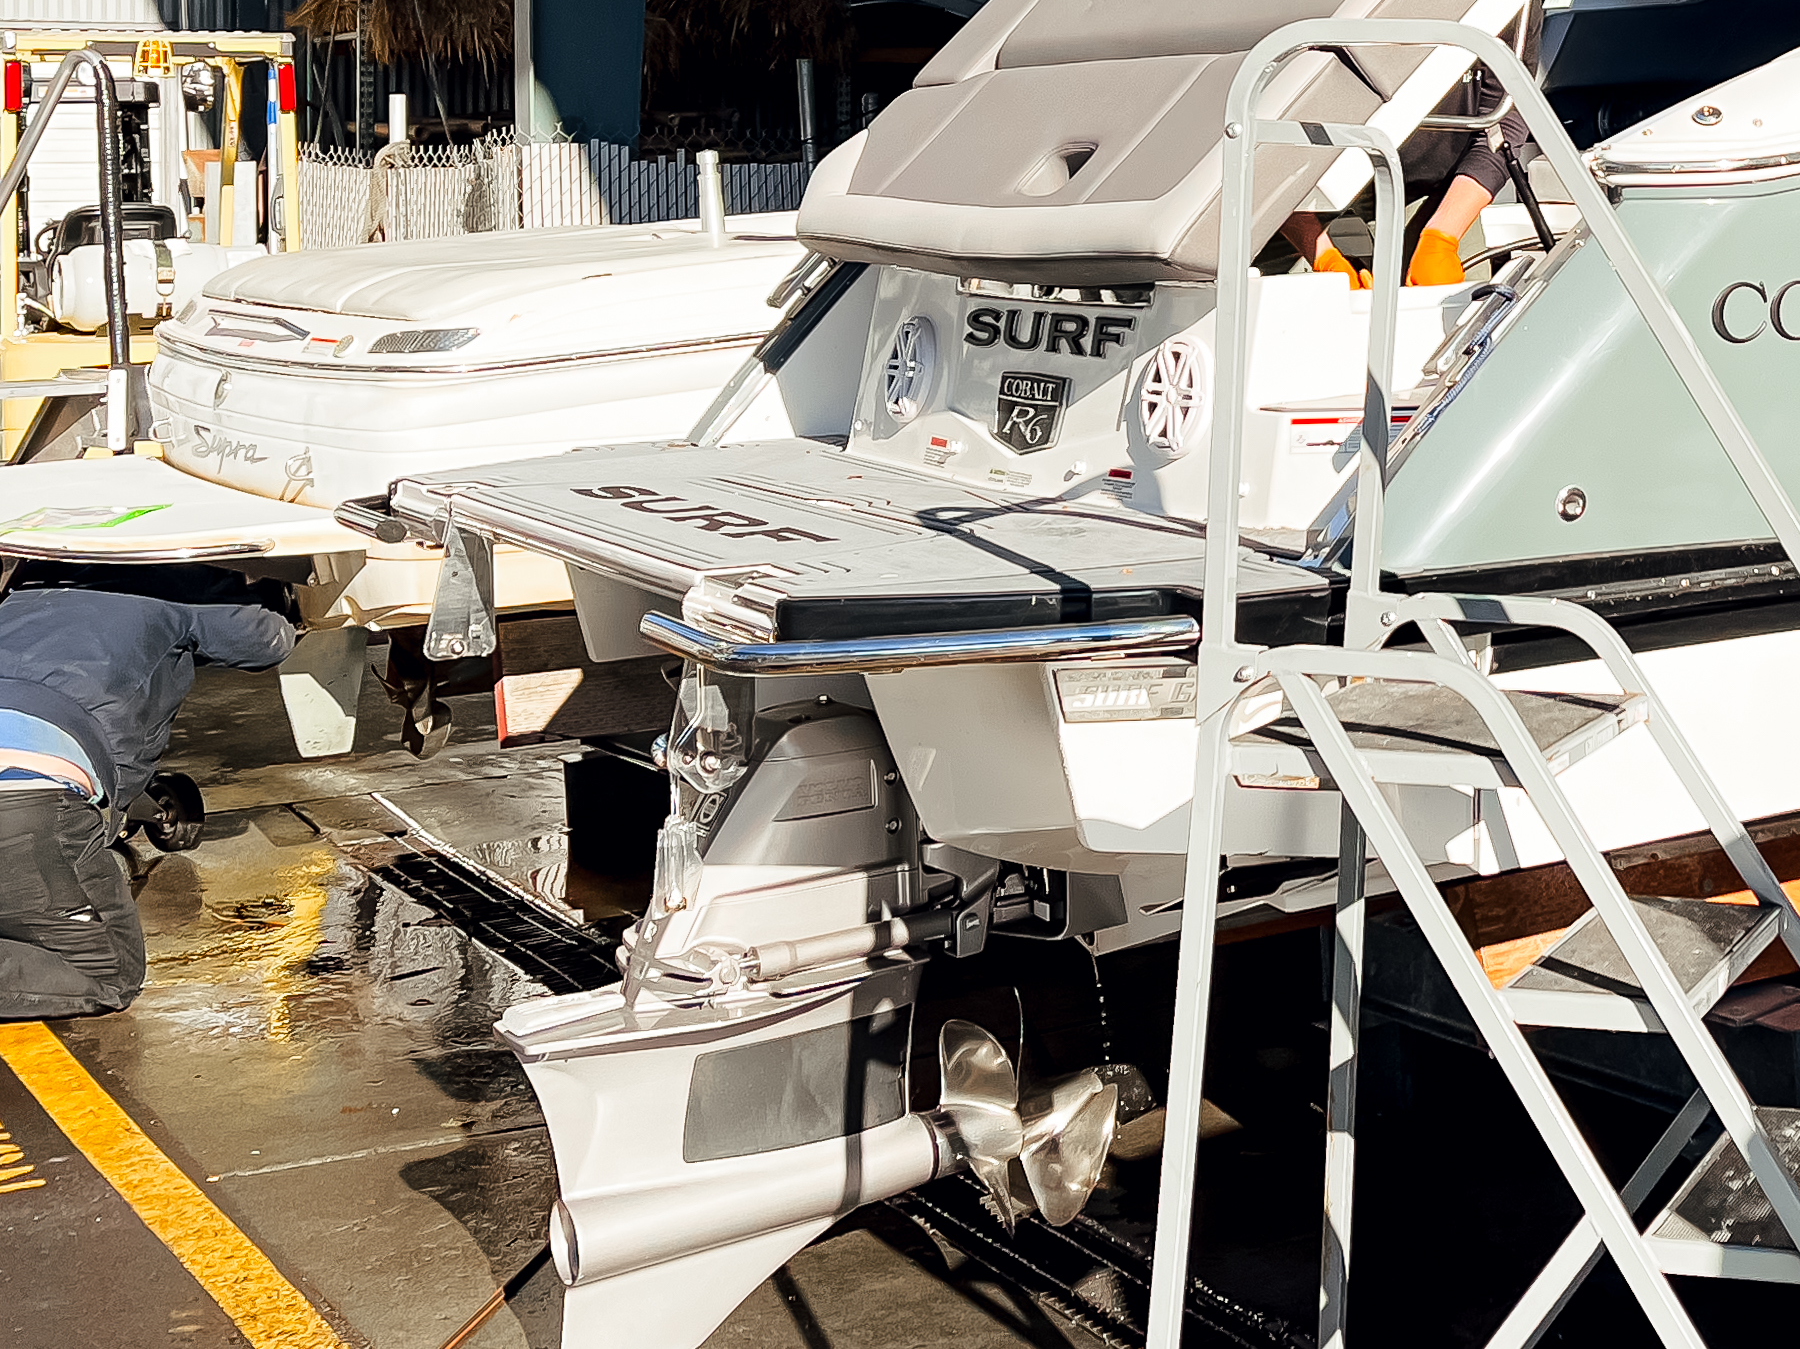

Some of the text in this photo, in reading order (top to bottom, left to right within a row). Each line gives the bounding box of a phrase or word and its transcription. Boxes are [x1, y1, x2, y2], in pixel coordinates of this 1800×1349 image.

[963, 306, 1137, 359] SURF
[1003, 377, 1057, 401] COBALT
[191, 424, 271, 475] Supra
[1002, 405, 1048, 445] R6
[569, 485, 841, 542] SURF
